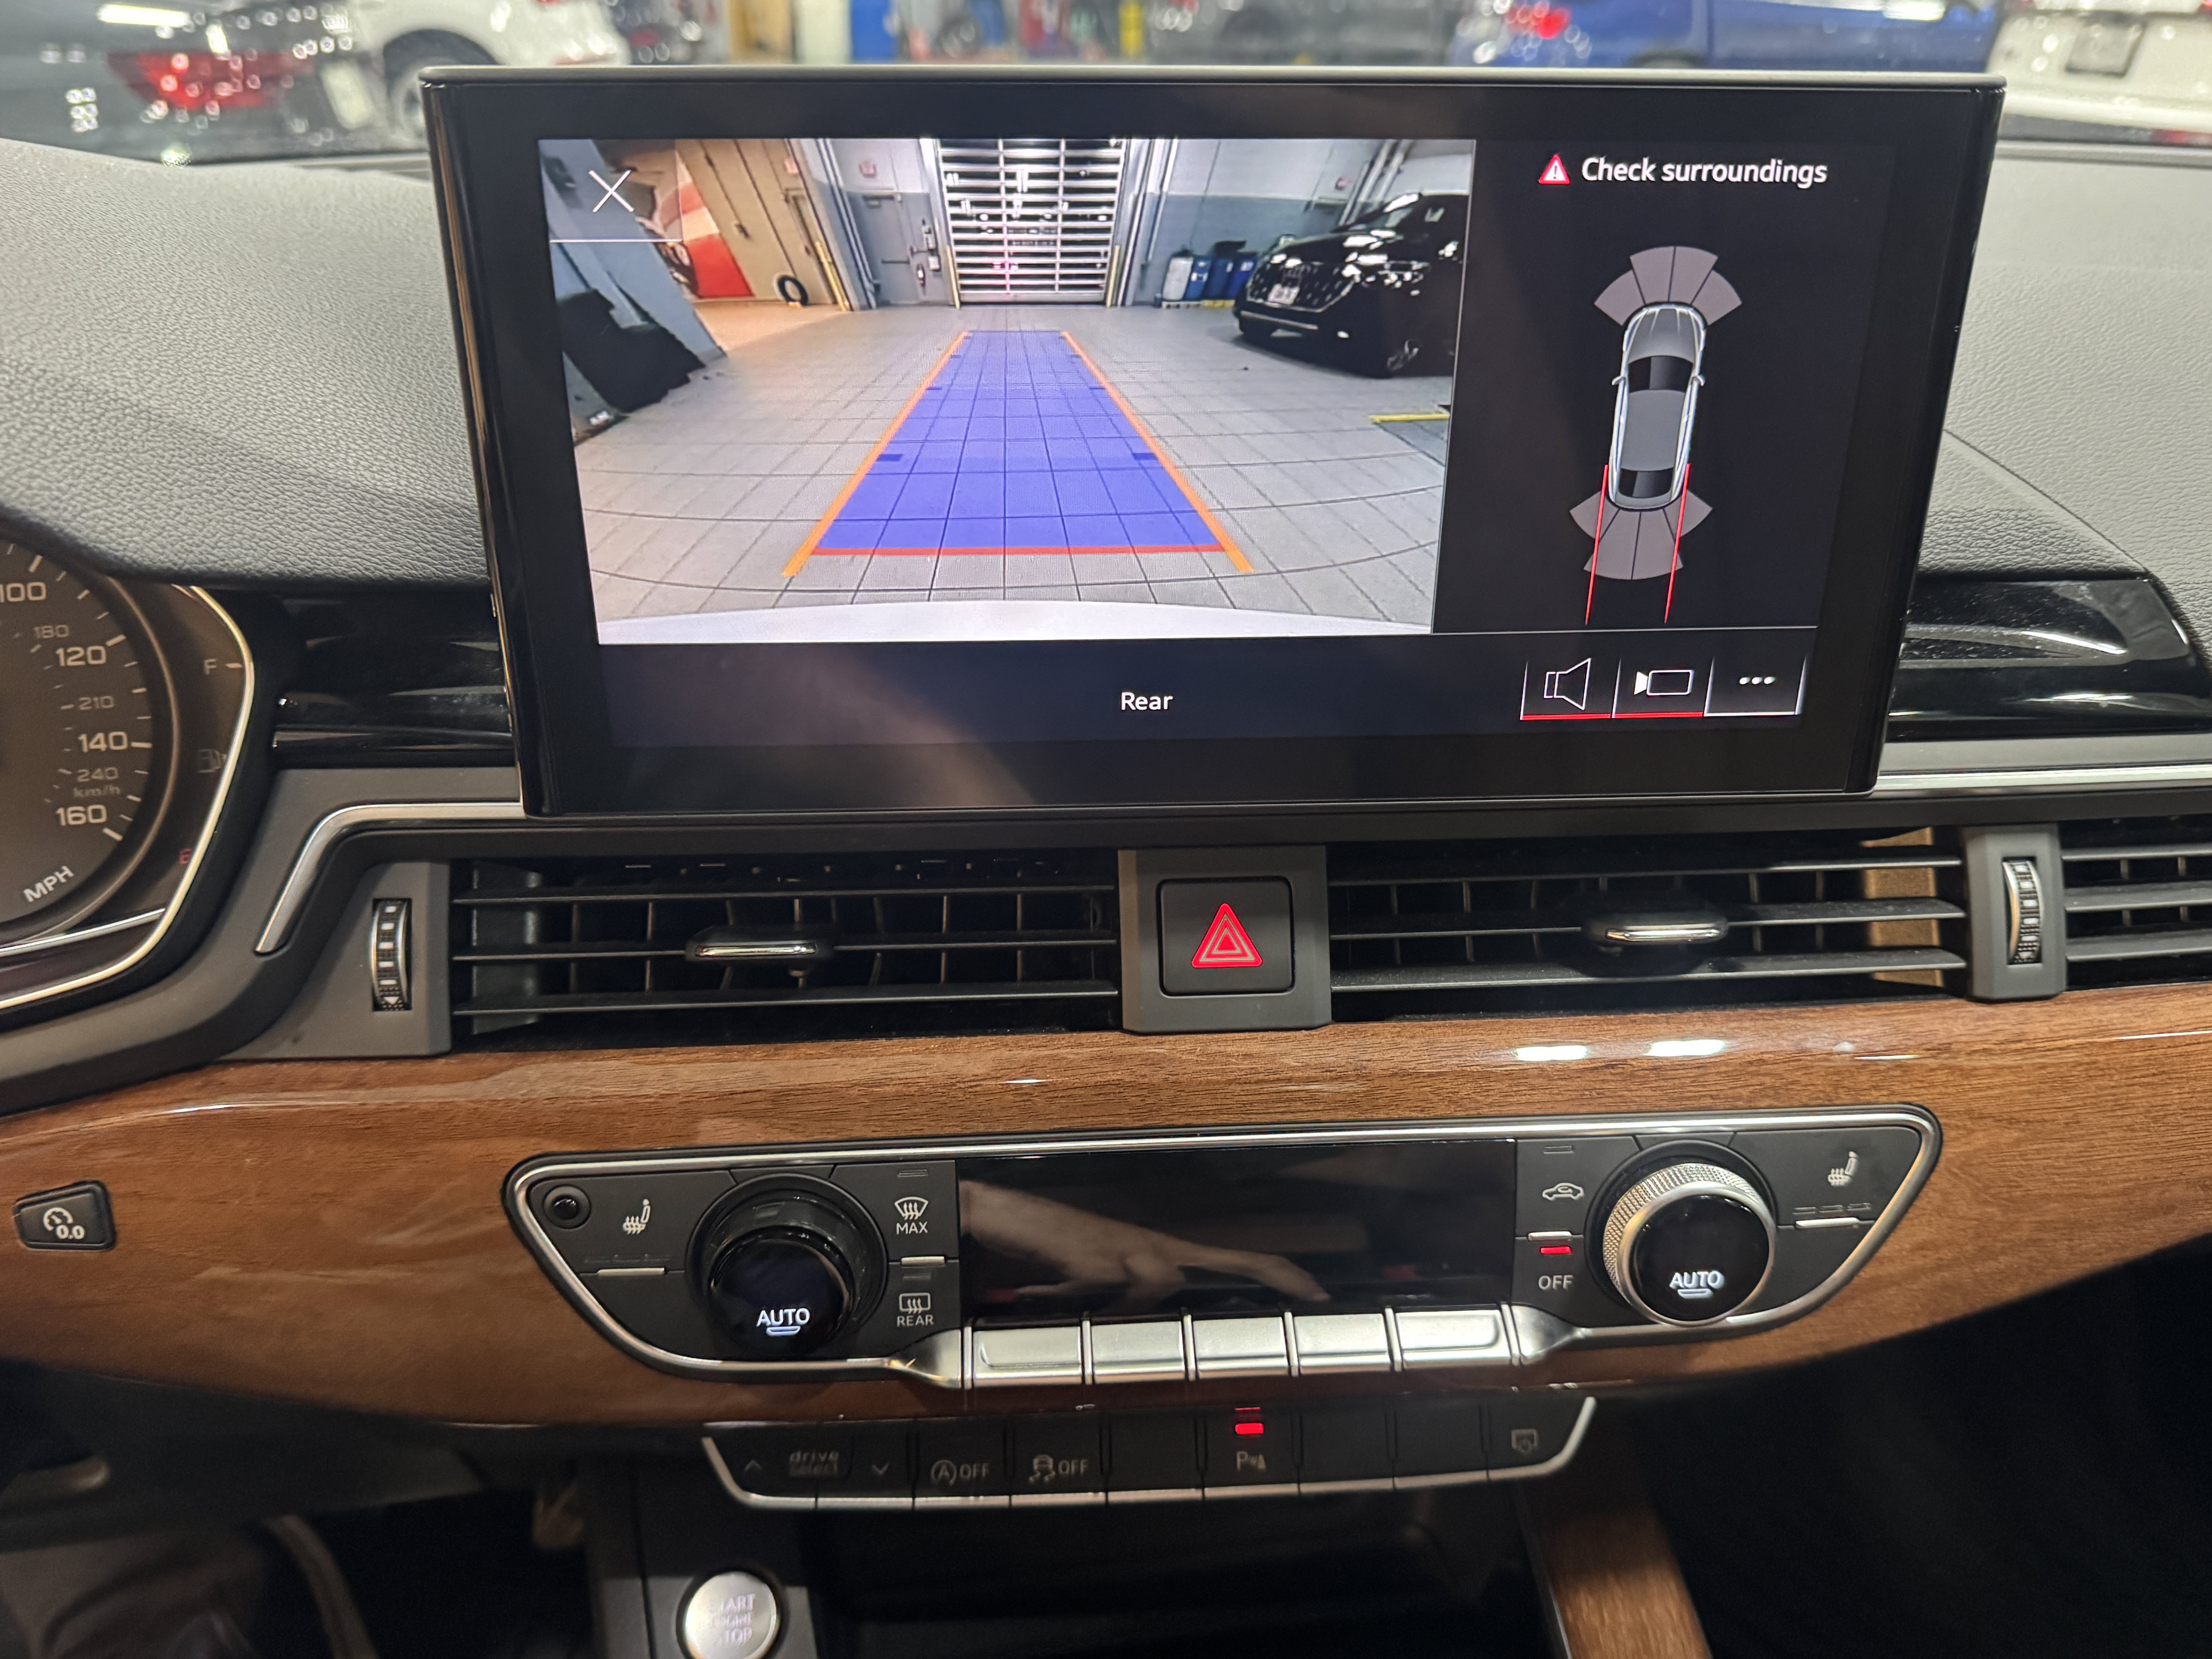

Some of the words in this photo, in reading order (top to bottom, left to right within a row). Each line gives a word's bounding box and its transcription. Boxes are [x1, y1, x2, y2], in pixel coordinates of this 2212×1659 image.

[1582, 156, 1655, 181] Check
[1661, 158, 1828, 189] surroundings
[0, 582, 46, 603] 100
[33, 624, 70, 639] 180
[55, 647, 107, 667] 120
[203, 659, 217, 675] F
[79, 696, 115, 711] 210
[1121, 692, 1173, 710] Rear
[77, 731, 128, 753] 140
[77, 767, 118, 782] 240
[55, 804, 107, 826] 160
[23, 866, 75, 903] MPH
[896, 1221, 928, 1235] MAX
[1538, 1275, 1573, 1291] OFF
[1669, 1271, 1724, 1289] AUTO
[756, 1307, 810, 1327] AUTO
[896, 1313, 934, 1326] REAR
[960, 1462, 990, 1480] OFF
[1058, 1459, 1089, 1475] OFF
